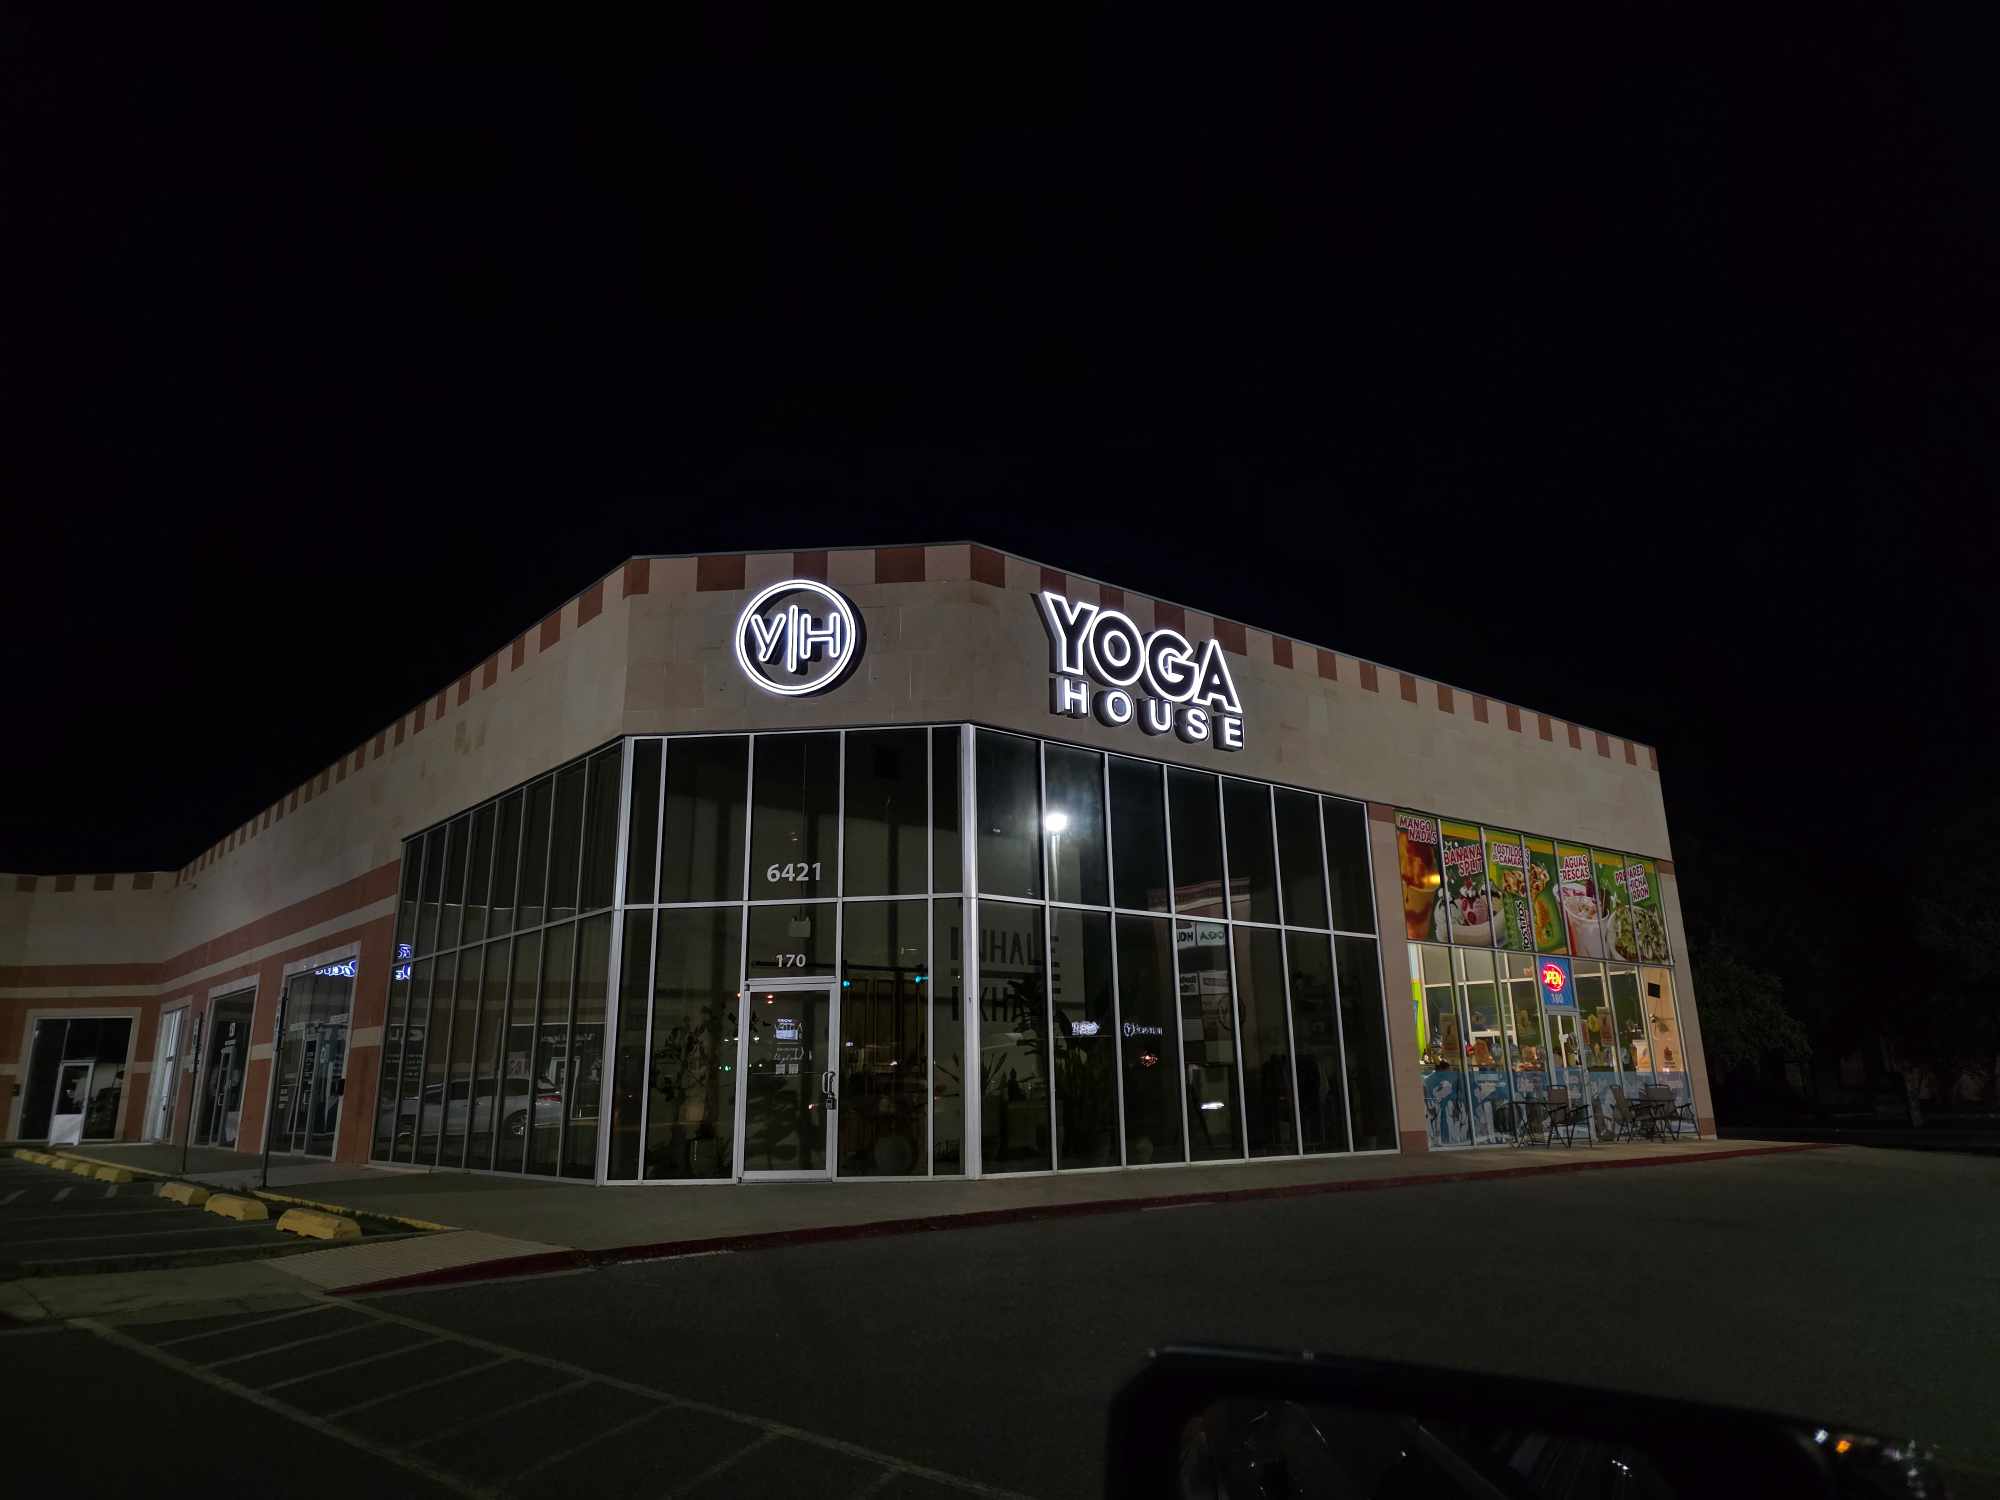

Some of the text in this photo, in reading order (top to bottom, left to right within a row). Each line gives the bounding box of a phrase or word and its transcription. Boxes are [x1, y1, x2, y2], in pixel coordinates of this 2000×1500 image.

[1042, 591, 1243, 714] YOGA
[1063, 678, 1244, 748] HOUSE
[1399, 815, 1431, 832] MANGO
[1408, 829, 1437, 845] NADAS
[1443, 846, 1482, 866] BANANA
[1564, 855, 1588, 869] AGUAS
[766, 862, 822, 882] 6421
[1458, 858, 1483, 876] SPLIT
[775, 953, 807, 968] 170
